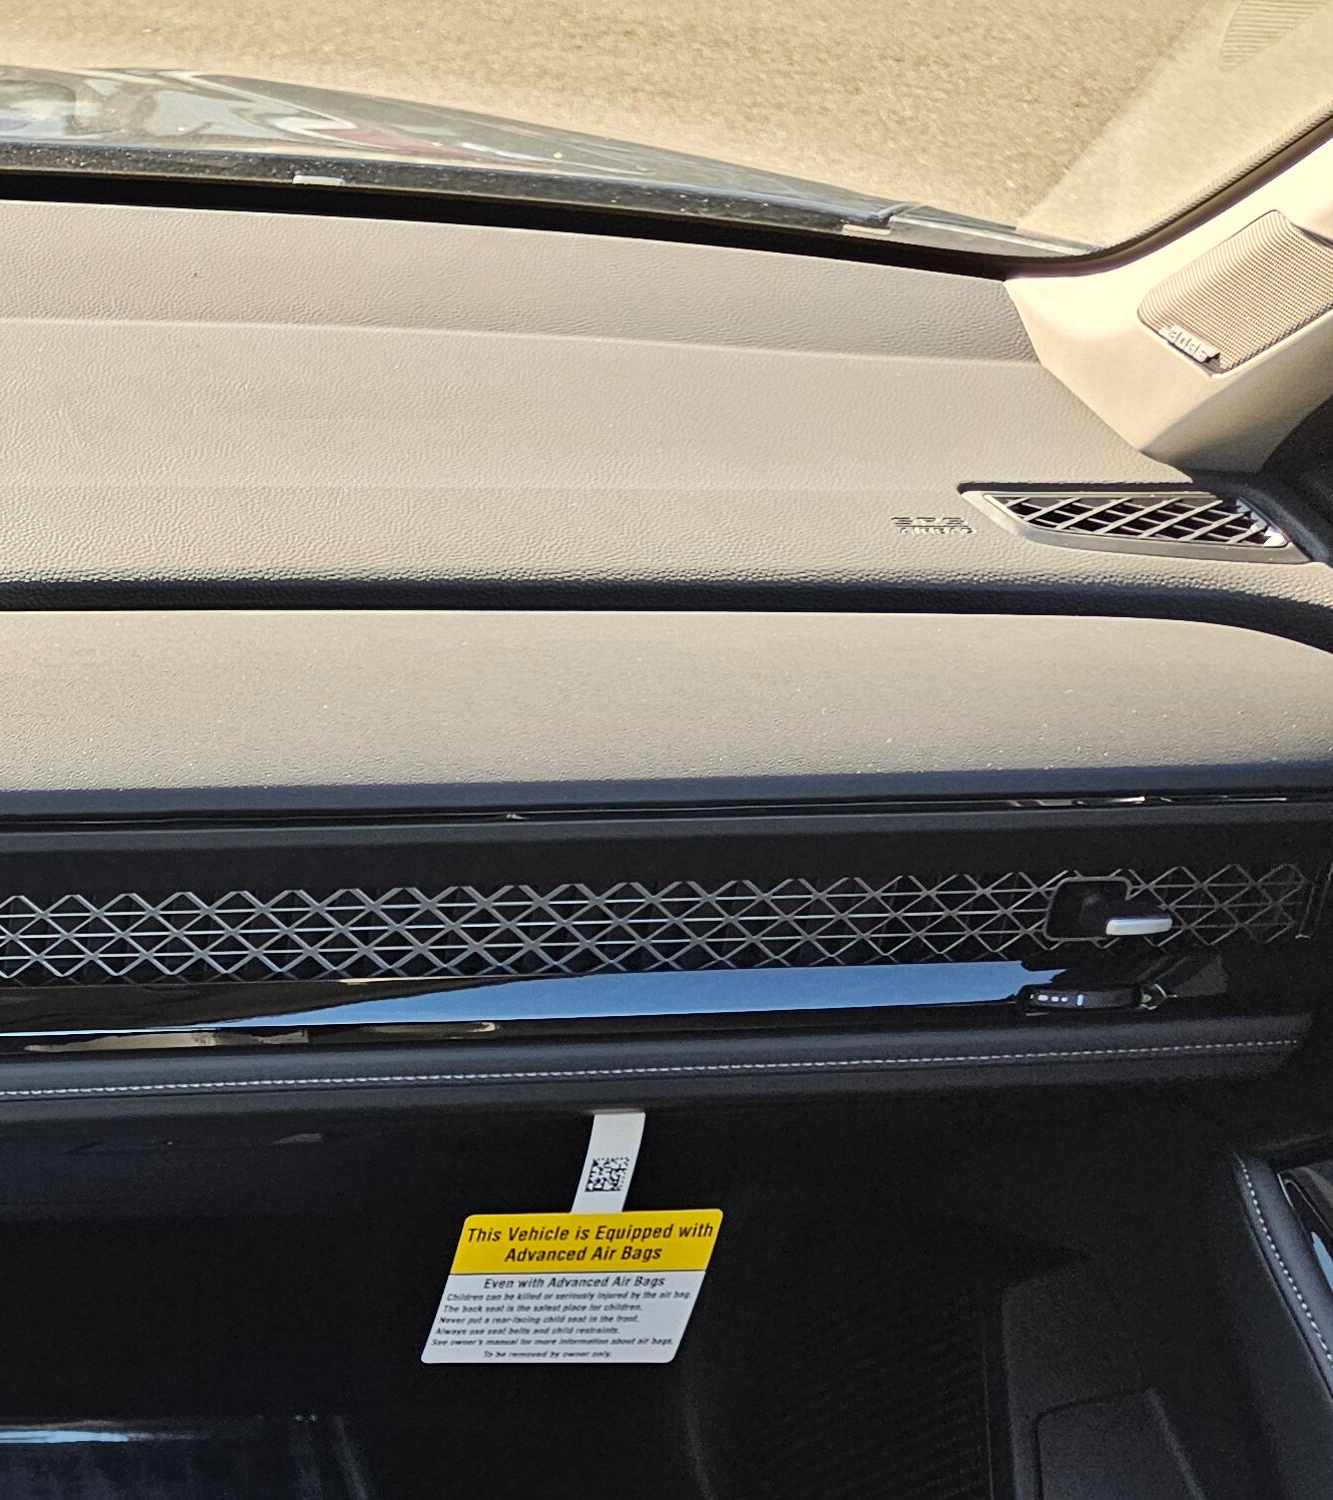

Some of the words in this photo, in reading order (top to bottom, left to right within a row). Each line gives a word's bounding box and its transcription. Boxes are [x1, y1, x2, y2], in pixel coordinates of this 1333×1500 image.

[468, 1228, 501, 1242] This
[508, 1226, 569, 1241] Vehicle
[575, 1225, 590, 1240] is
[595, 1224, 674, 1242] Equipped
[679, 1222, 713, 1238] with
[504, 1247, 588, 1262] Advanced
[591, 1246, 617, 1261] Air
[621, 1246, 662, 1263] Bags
[484, 1278, 514, 1289] Even
[518, 1277, 544, 1288] with
[547, 1276, 610, 1289] Advanced
[611, 1276, 631, 1287] Air
[634, 1276, 665, 1289] Bags
